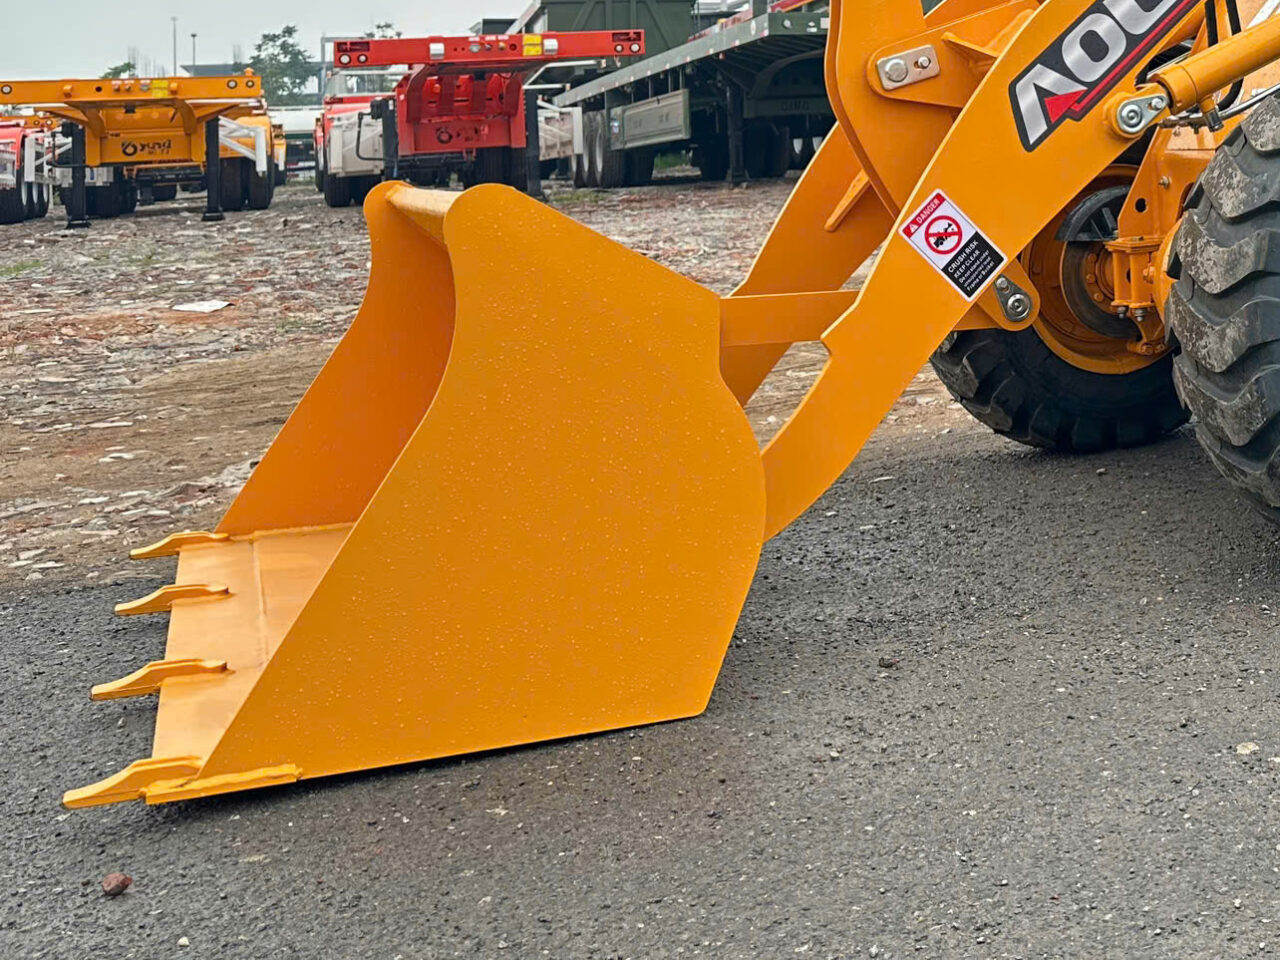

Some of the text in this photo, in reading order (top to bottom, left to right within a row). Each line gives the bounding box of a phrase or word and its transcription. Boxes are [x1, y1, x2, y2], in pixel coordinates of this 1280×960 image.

[915, 198, 941, 224] DANGER
[948, 240, 979, 273] CRUSH RISK
[954, 250, 980, 278] KEEP CLEAR
